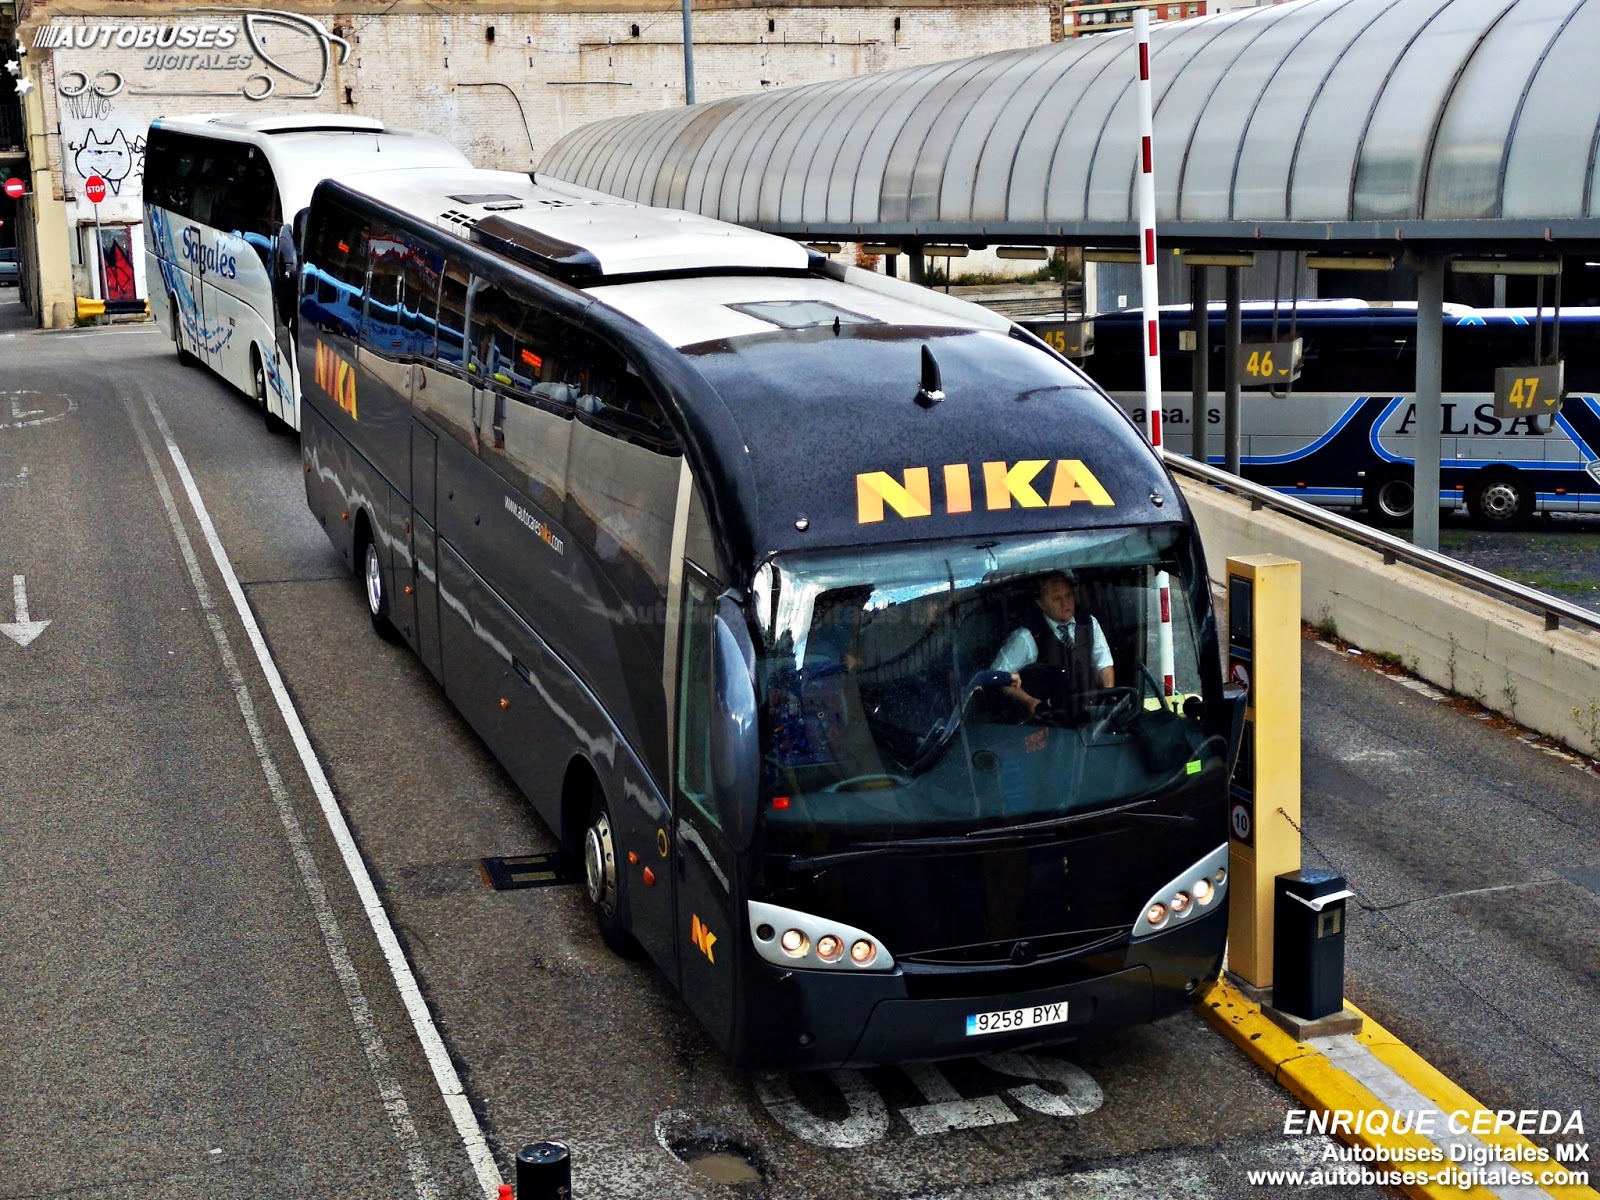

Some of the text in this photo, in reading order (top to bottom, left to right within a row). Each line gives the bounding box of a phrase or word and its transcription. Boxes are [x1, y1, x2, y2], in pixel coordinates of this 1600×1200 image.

[86, 184, 106, 195] STOP
[182, 226, 237, 280] Sagalés
[1044, 330, 1066, 353] 45
[1246, 351, 1274, 378] 46
[315, 338, 358, 421] NIKA
[1508, 377, 1540, 409] 47
[1132, 407, 1221, 424] asa.s
[856, 458, 1116, 525] NIKA
[1234, 812, 1248, 832] 10
[978, 1003, 1062, 1031] 9258 BYX
